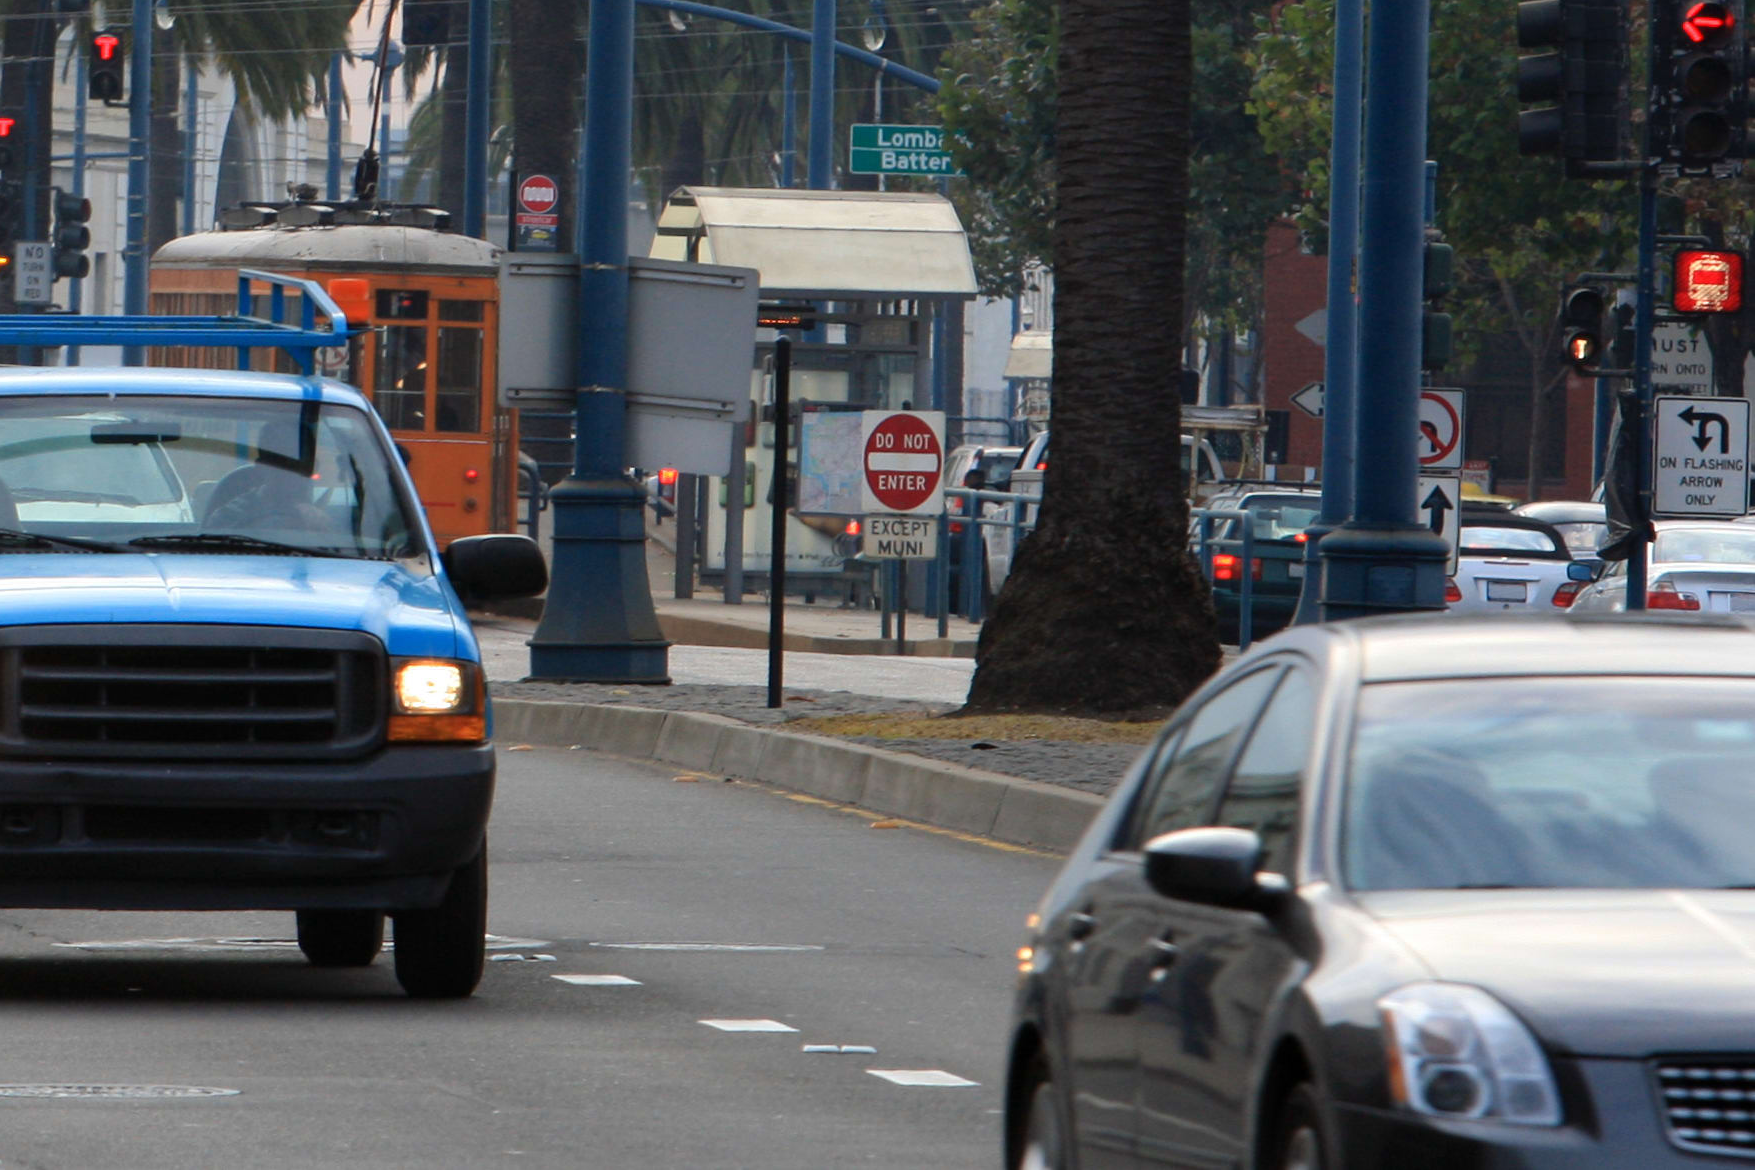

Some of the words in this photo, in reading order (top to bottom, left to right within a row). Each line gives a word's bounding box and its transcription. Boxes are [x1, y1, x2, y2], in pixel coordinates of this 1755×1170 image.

[882, 151, 953, 171] Batter
[25, 246, 44, 259] NO
[1676, 363, 1706, 375] ONTO
[876, 433, 894, 448] DO
[904, 434, 931, 449] NOT
[1659, 457, 1677, 469] ON
[1684, 458, 1743, 471] FLASHING
[878, 475, 926, 490] ENTER
[1679, 476, 1724, 487] ARROW
[1685, 494, 1716, 506] ONLY
[871, 520, 930, 537] EXCEPT
[878, 540, 923, 557] MUNI
